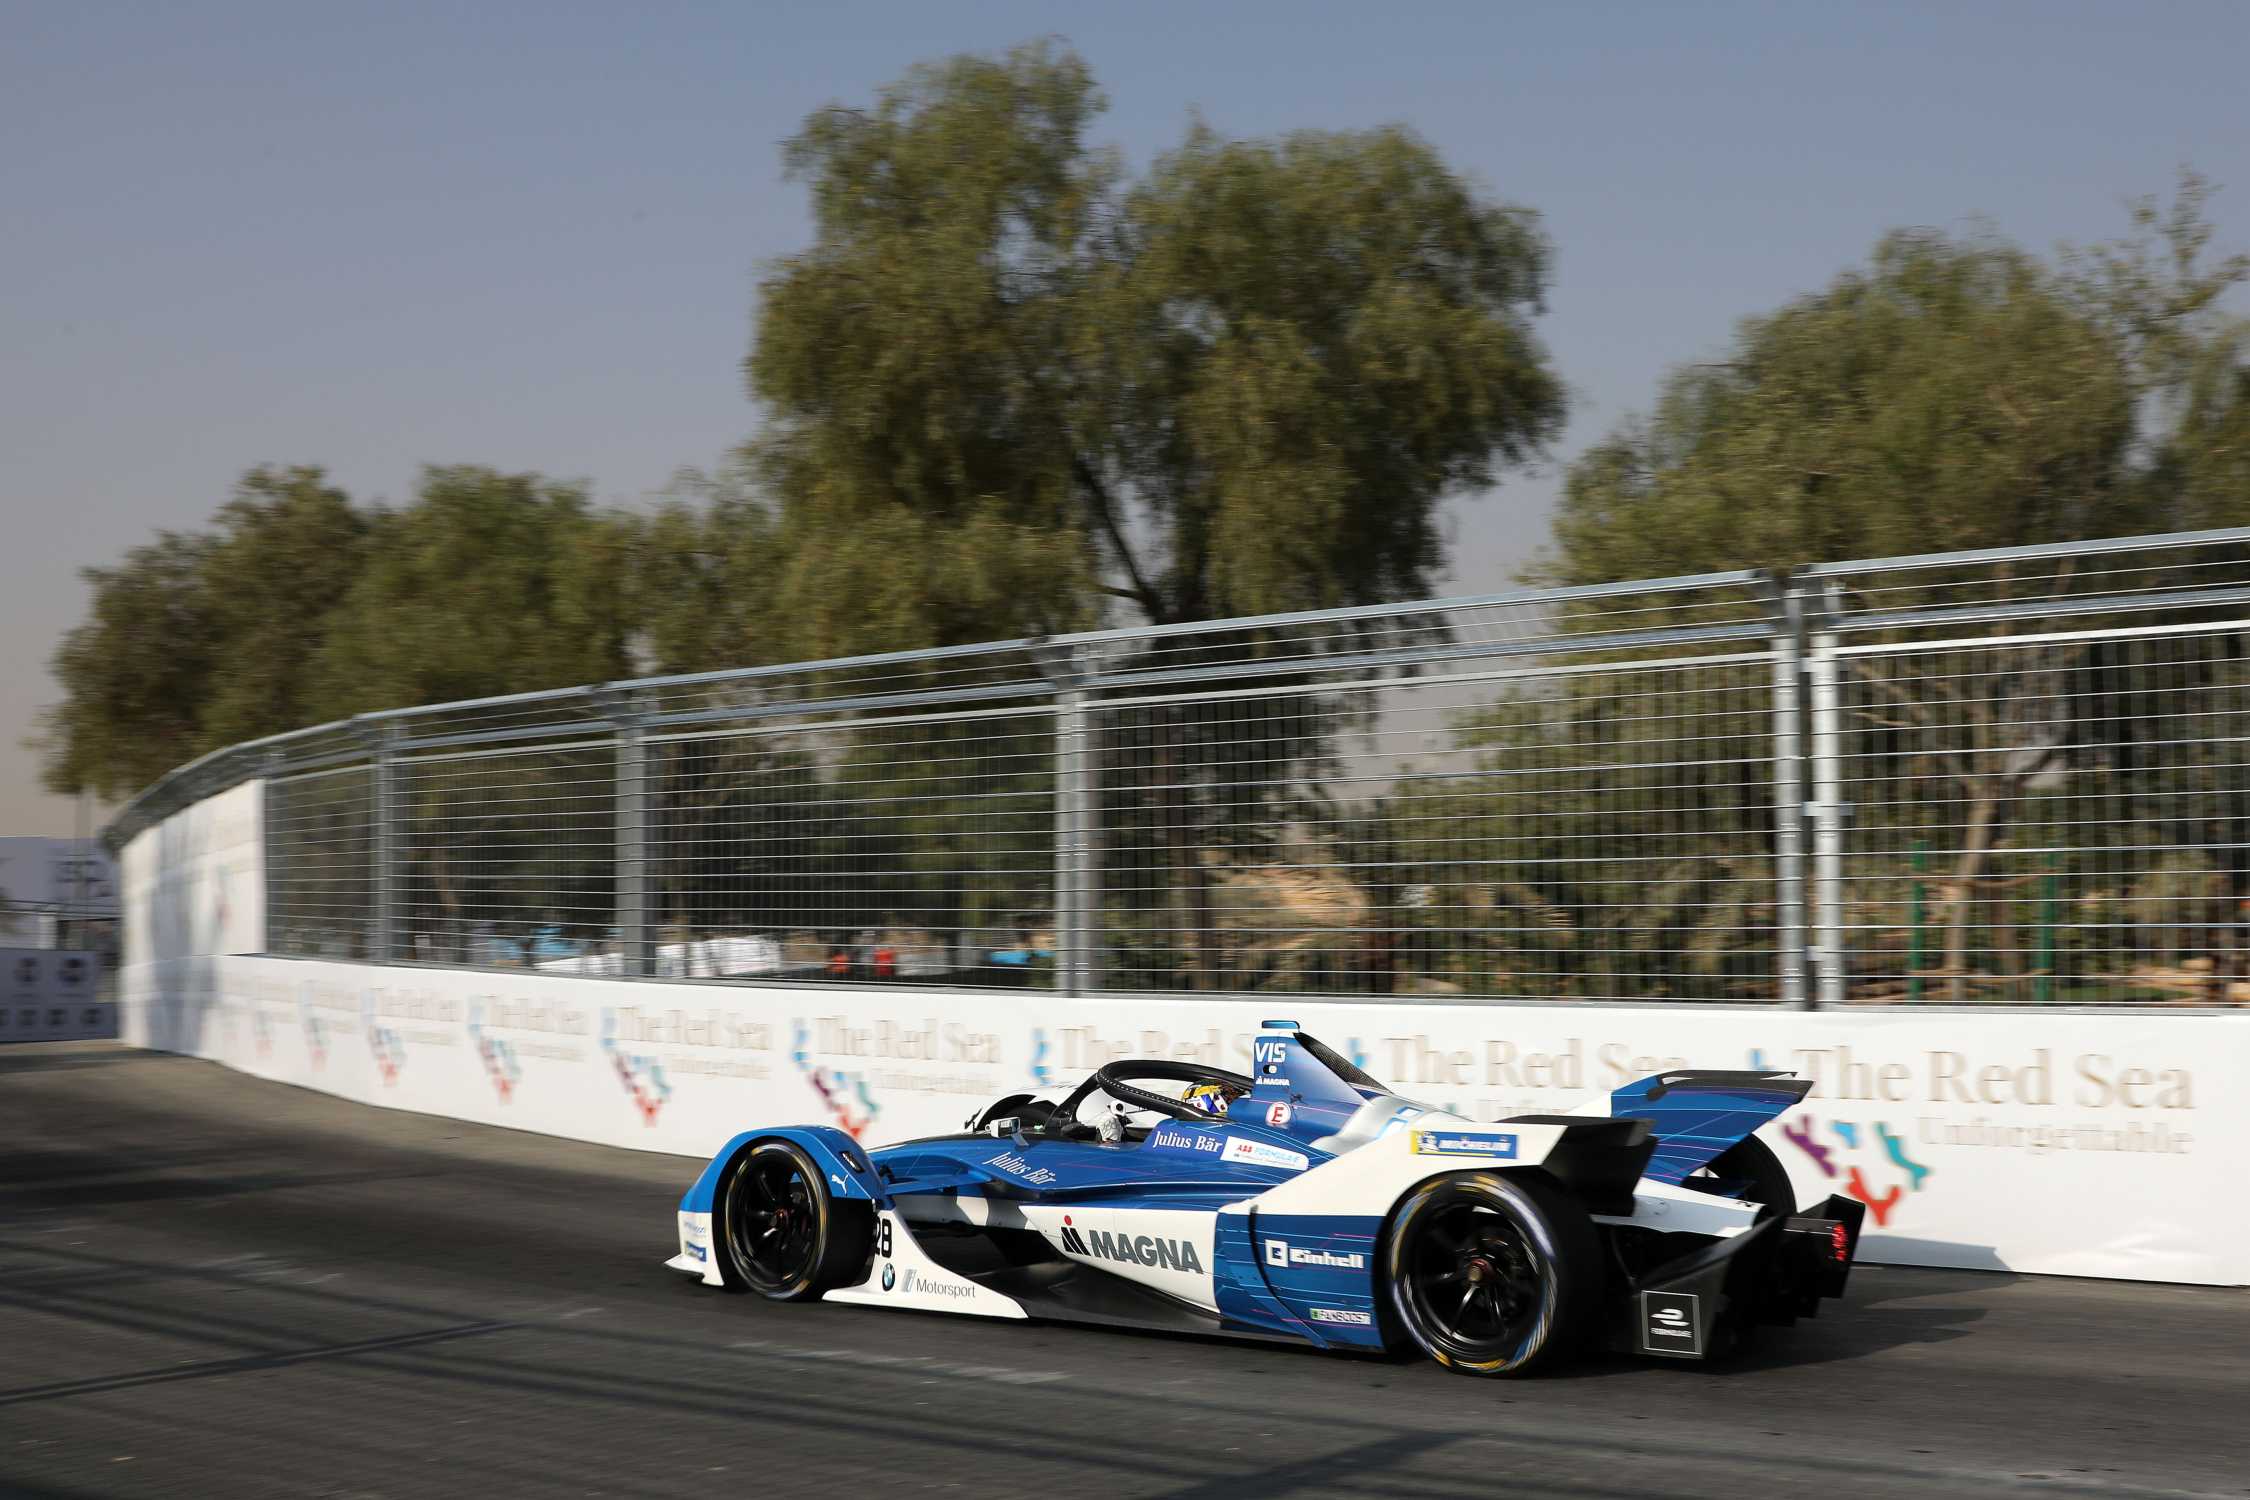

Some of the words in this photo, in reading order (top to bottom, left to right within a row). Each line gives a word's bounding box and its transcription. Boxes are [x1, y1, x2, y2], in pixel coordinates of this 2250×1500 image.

[815, 1015, 871, 1056] The
[874, 1018, 938, 1060] Red
[944, 1022, 1001, 1063] Sea
[1057, 1025, 1136, 1069] The
[1139, 1028, 1222, 1069] Red
[1255, 1042, 1286, 1063] VIS
[1381, 1035, 1475, 1085] The
[1484, 1038, 1585, 1090] Red
[1263, 1077, 1290, 1087] MAGNA
[1794, 1046, 1911, 1101] The
[1926, 1048, 2056, 1106] Red
[2074, 1053, 2195, 1110] Sea
[1271, 1106, 1284, 1123] E
[1152, 1130, 1192, 1149] Julius
[1194, 1135, 1223, 1153] Bär
[981, 1151, 1031, 1175] Julius
[1021, 1167, 1056, 1185] Bär
[1088, 1229, 1204, 1275] MAGNA
[1289, 1248, 1364, 1269] Einhell
[916, 1278, 976, 1299] Motorsport
